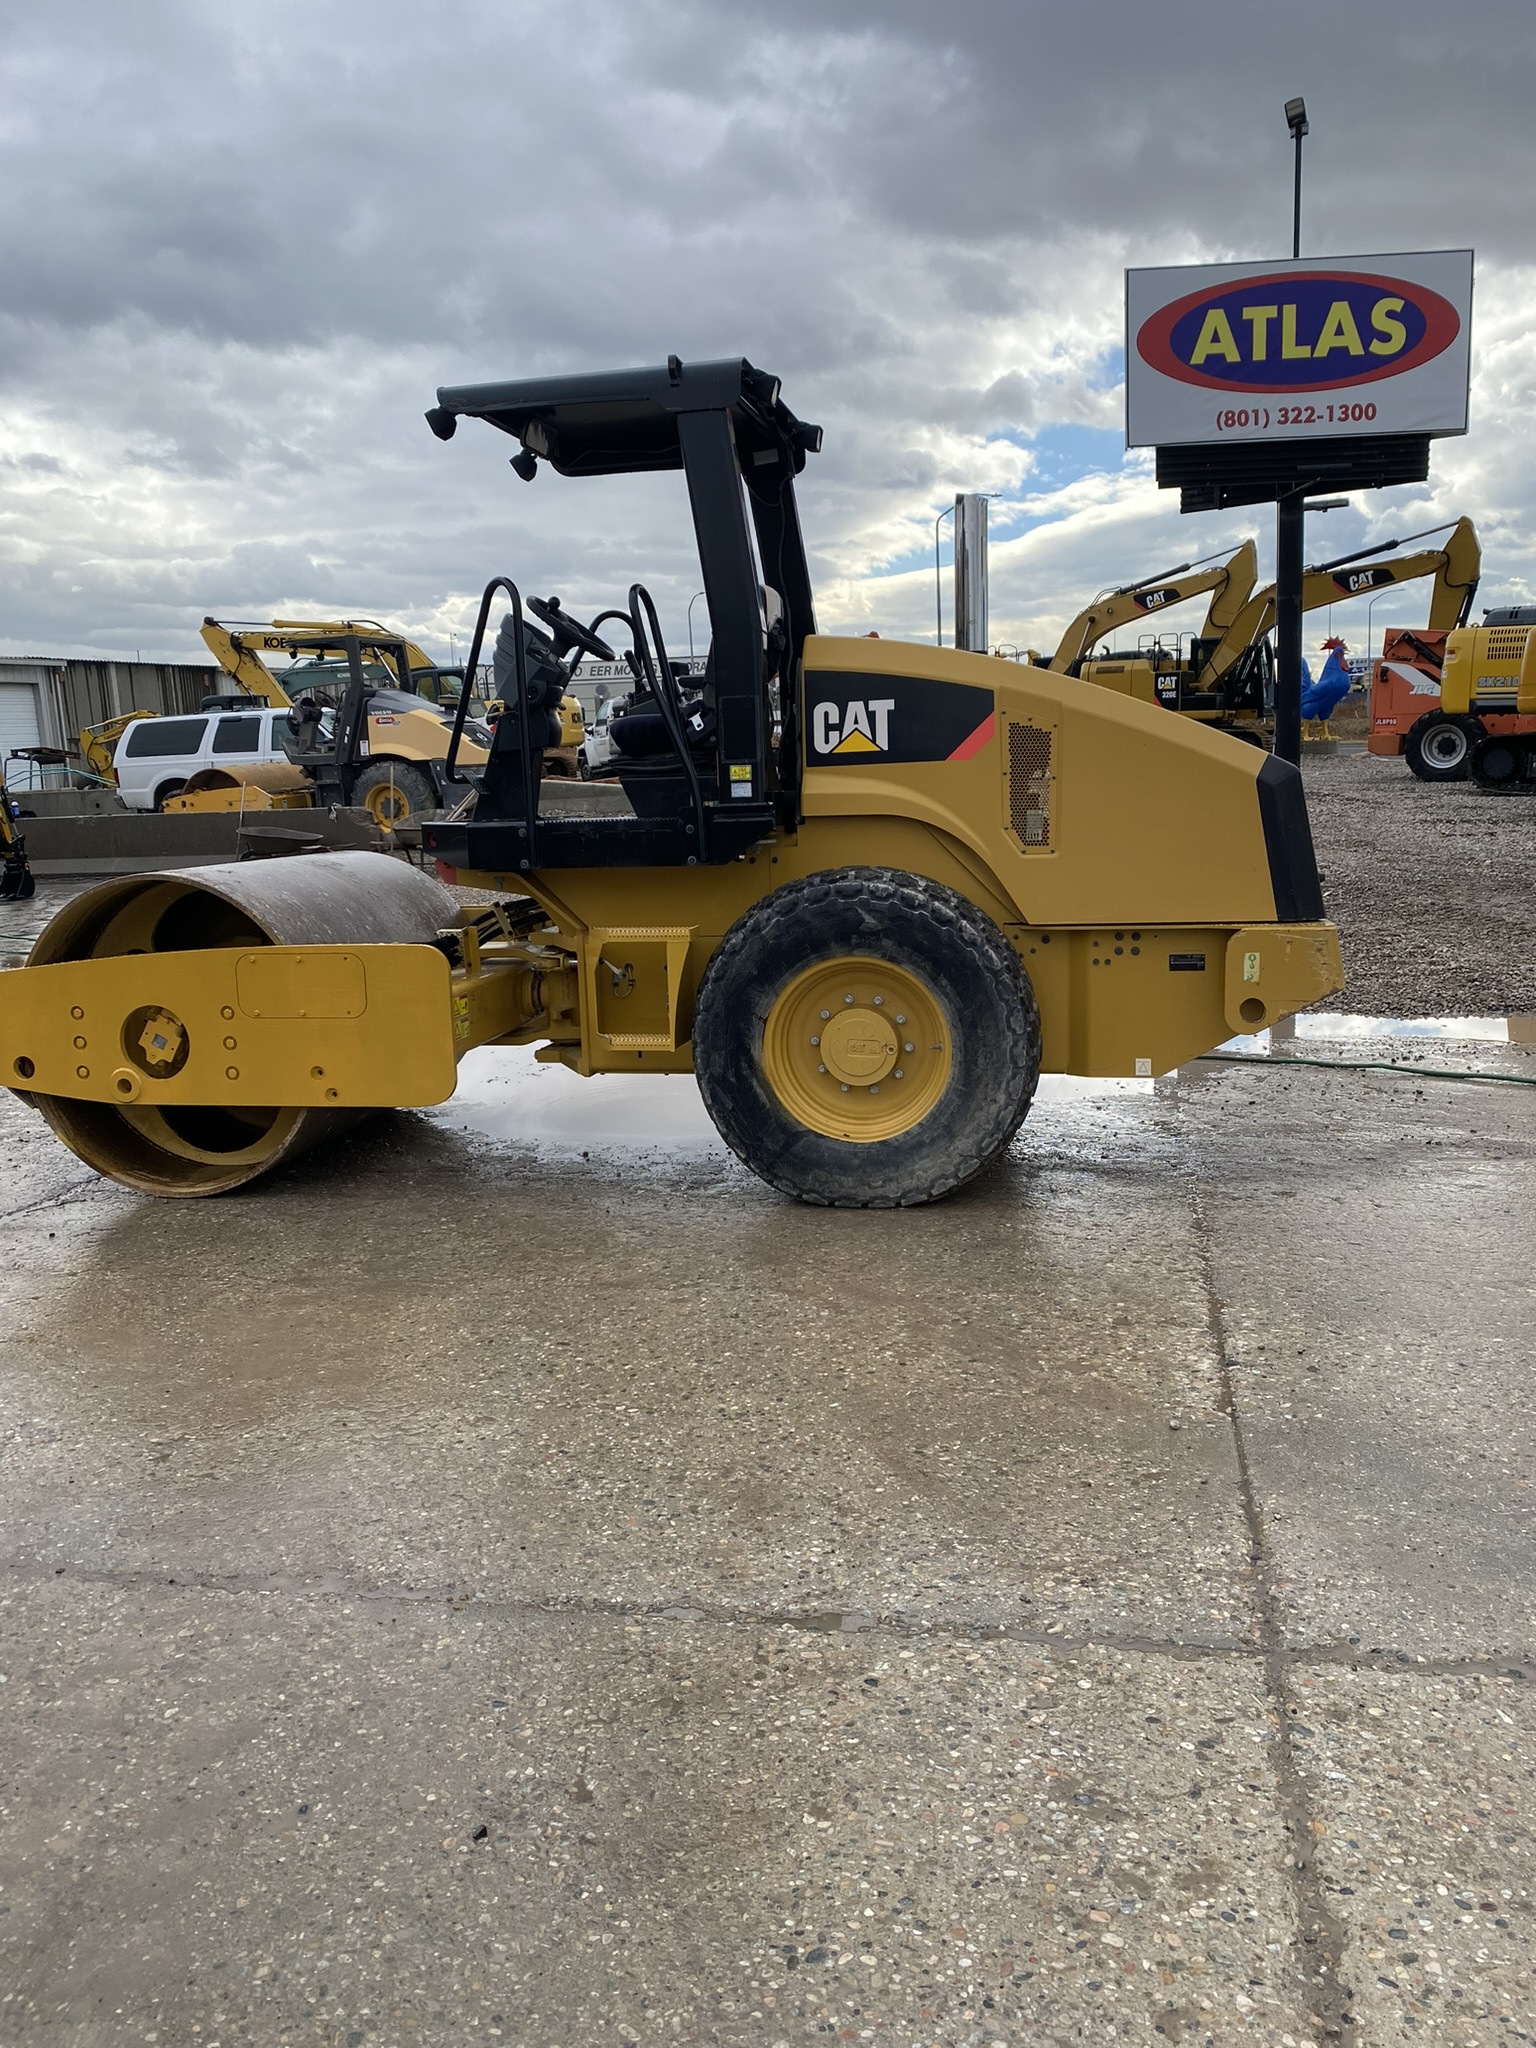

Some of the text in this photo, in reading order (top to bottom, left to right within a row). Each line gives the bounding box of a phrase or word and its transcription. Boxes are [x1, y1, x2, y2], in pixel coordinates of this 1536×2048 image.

[1190, 297, 1407, 365] ATLAS
[1216, 402, 1377, 431] (801) 322-1300
[1349, 570, 1374, 591] CAT
[1146, 590, 1165, 608] CAT
[1157, 676, 1177, 689] CAT
[813, 699, 895, 754] CAT
